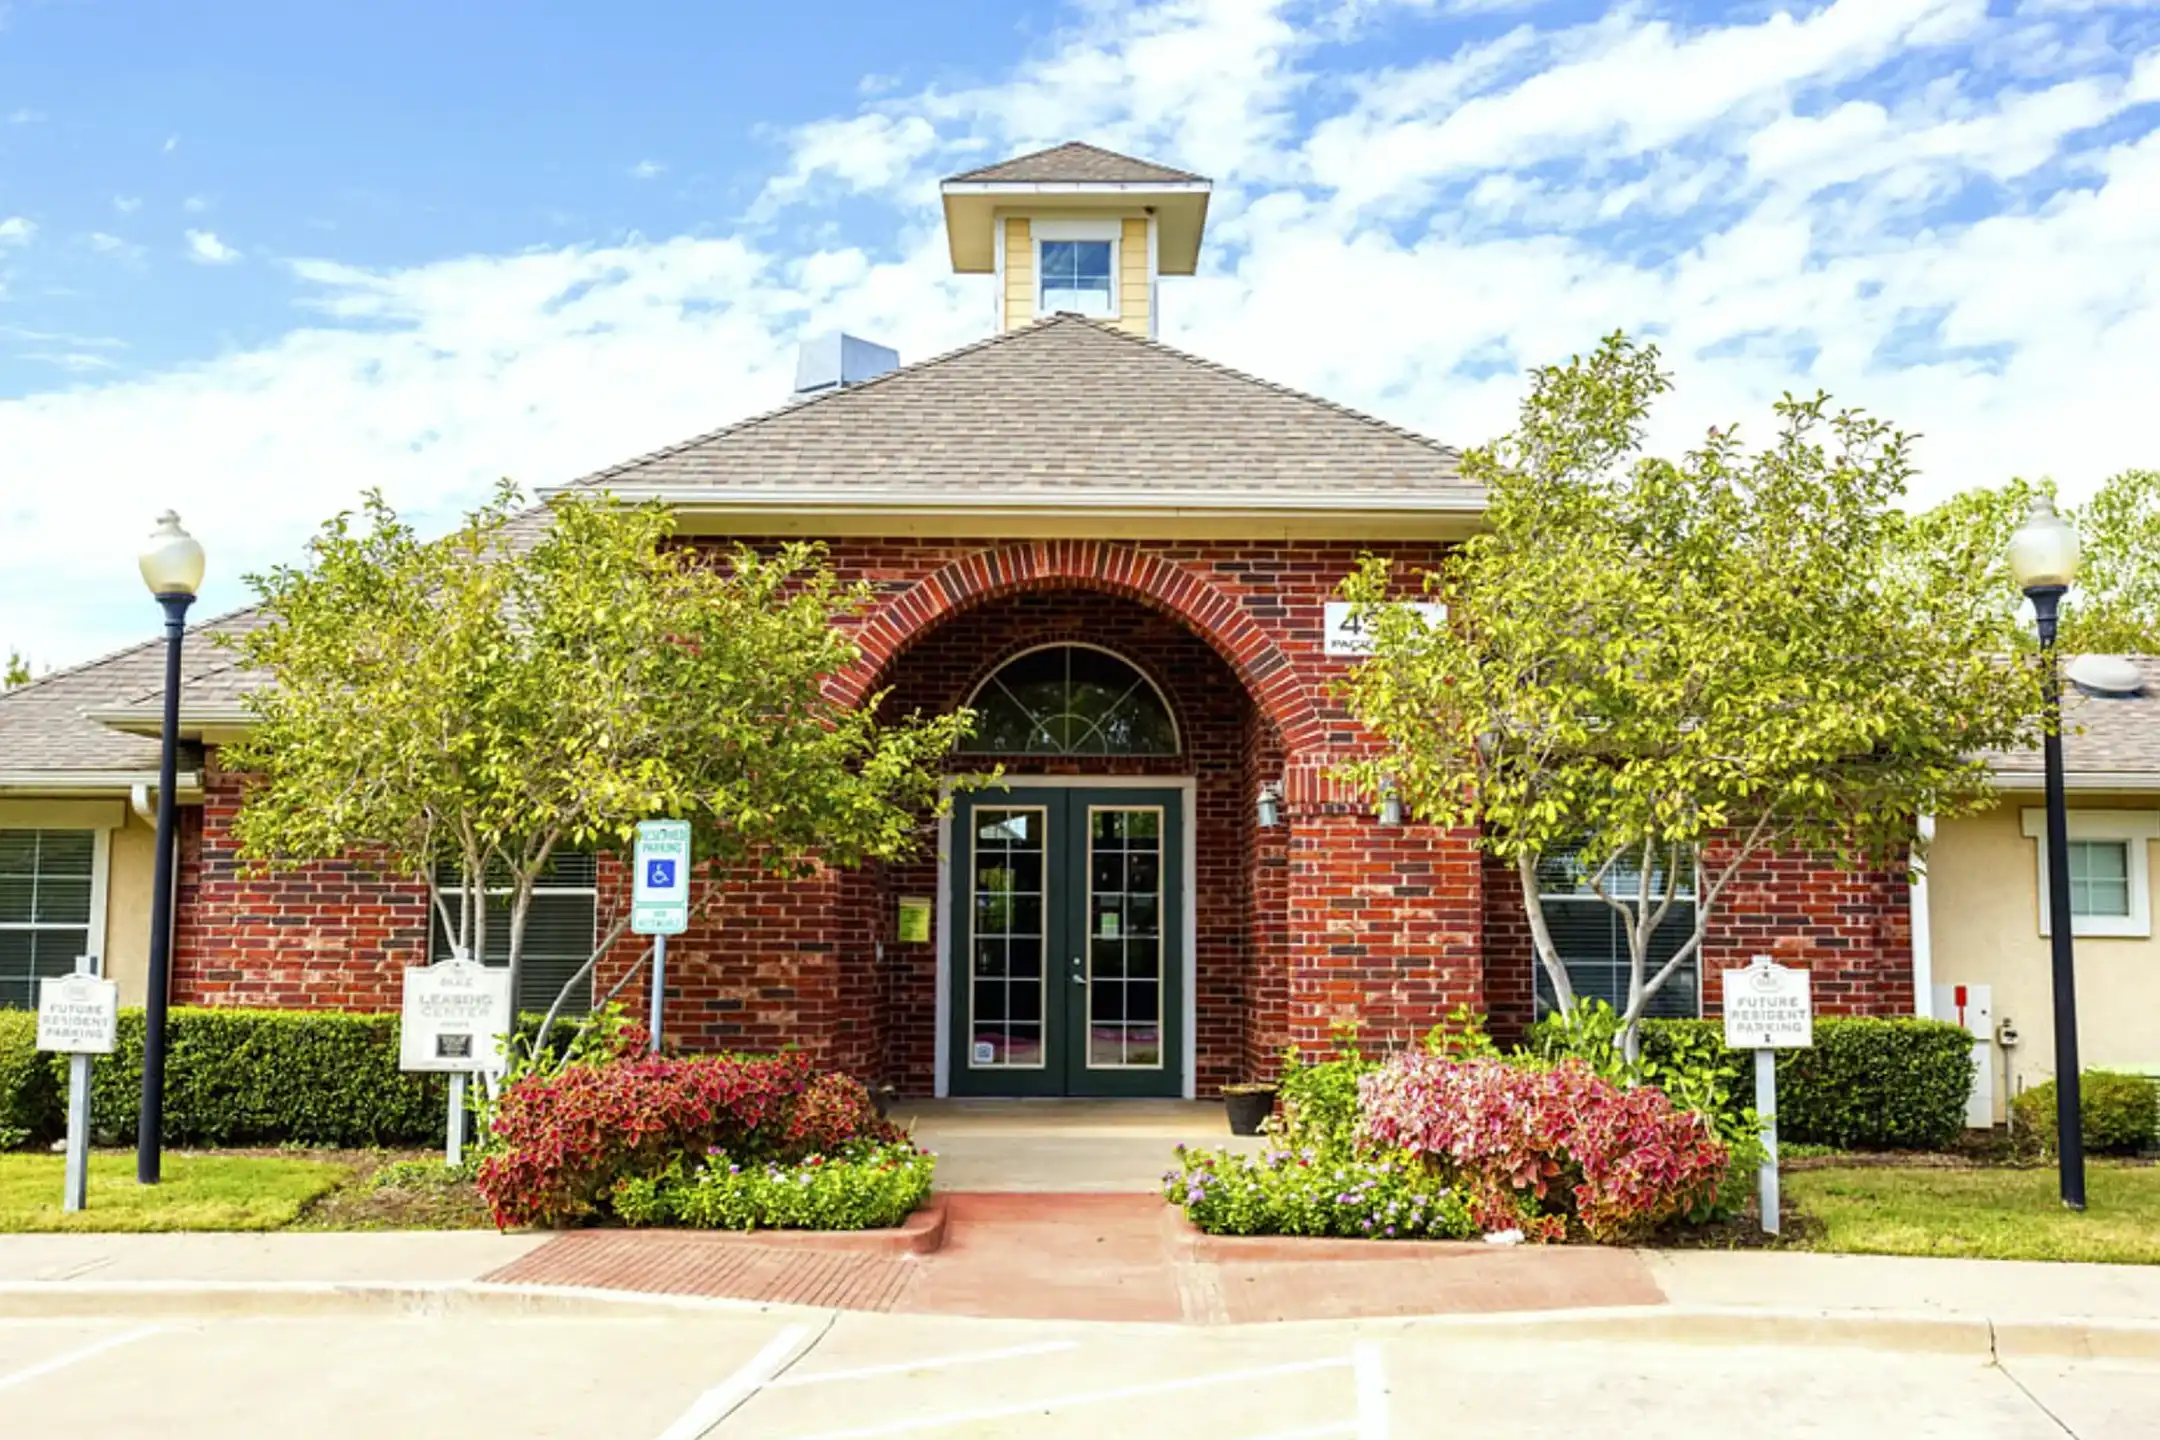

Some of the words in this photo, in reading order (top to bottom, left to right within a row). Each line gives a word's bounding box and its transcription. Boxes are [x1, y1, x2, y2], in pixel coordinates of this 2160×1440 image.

[419, 994, 493, 1005] LEASING
[1736, 996, 1799, 1007] FUTURE
[50, 1004, 104, 1015] FUTURE
[421, 1006, 491, 1018] CENTER
[1732, 1009, 1807, 1020] RESIDENT
[42, 1015, 108, 1027] RESIDENT
[45, 1027, 104, 1039] PARKING
[1736, 1022, 1802, 1033] PARKING
